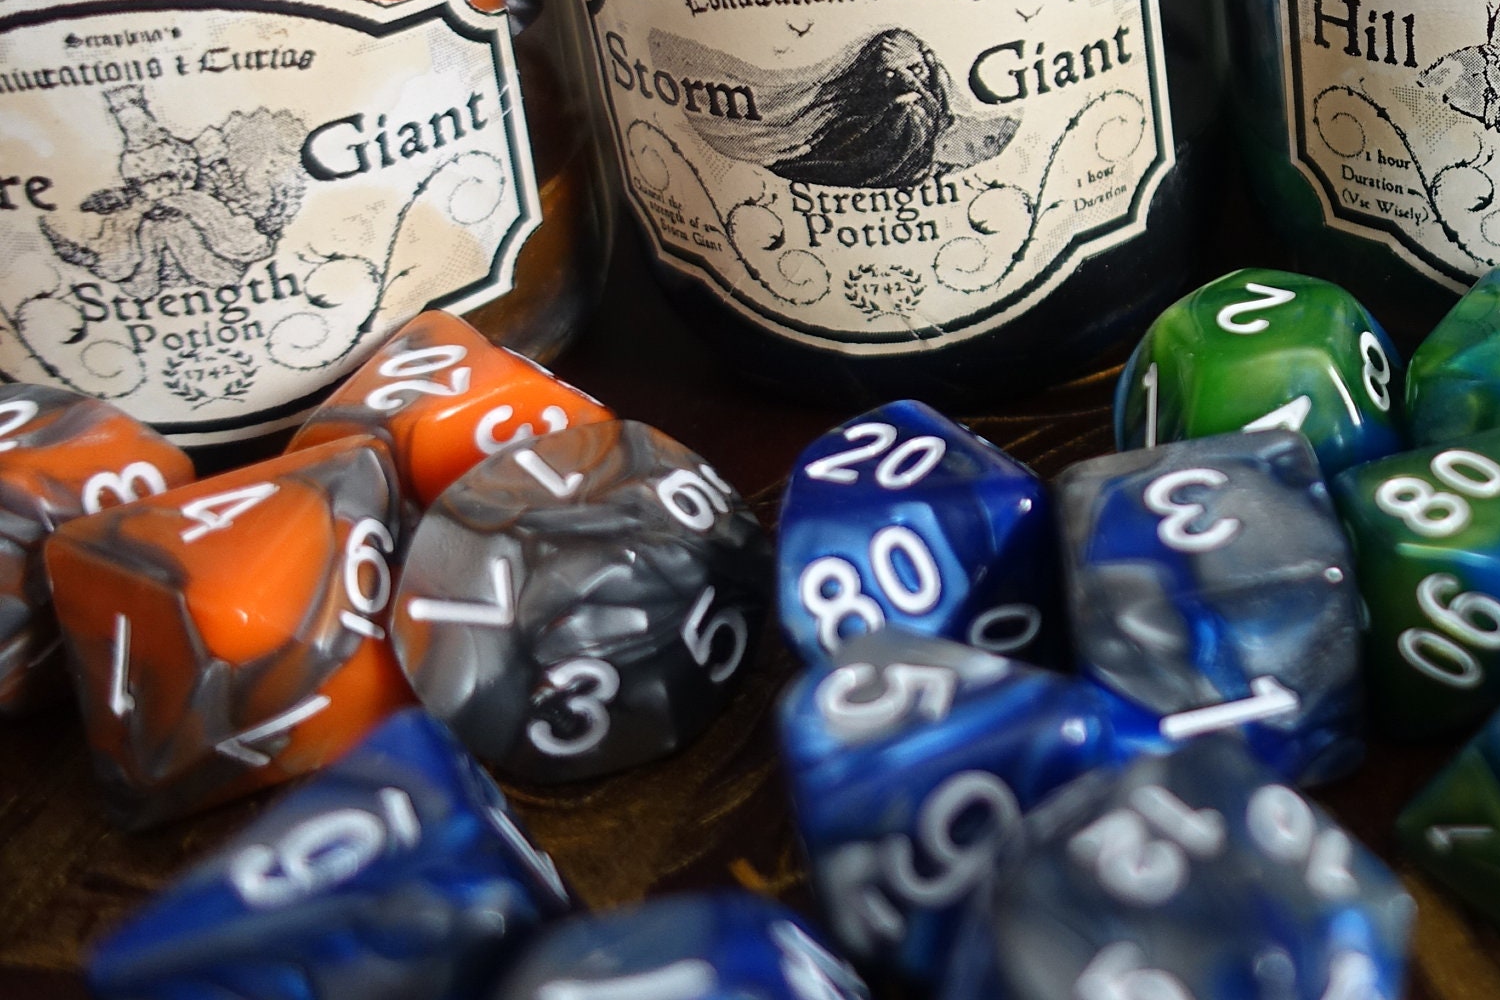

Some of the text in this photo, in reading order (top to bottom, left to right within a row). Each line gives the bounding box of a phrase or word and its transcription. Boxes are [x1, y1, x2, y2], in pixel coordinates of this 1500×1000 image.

[604, 22, 1134, 123] Storm Giant
[0, 88, 490, 212] re Giant
[1086, 163, 1117, 184] hour
[1340, 163, 1405, 195] Duration
[1376, 148, 1412, 170] hour
[788, 171, 962, 223] Strength
[803, 210, 941, 248] Potion
[69, 263, 302, 327] Strength
[861, 281, 907, 297] 1742
[1215, 281, 1297, 336] 2
[127, 316, 268, 355] Potion
[804, 421, 947, 491] 20
[180, 481, 281, 543] 4
[1142, 467, 1241, 551] 3
[801, 524, 943, 655] 80
[683, 585, 748, 683] 5
[526, 655, 621, 757] 3
